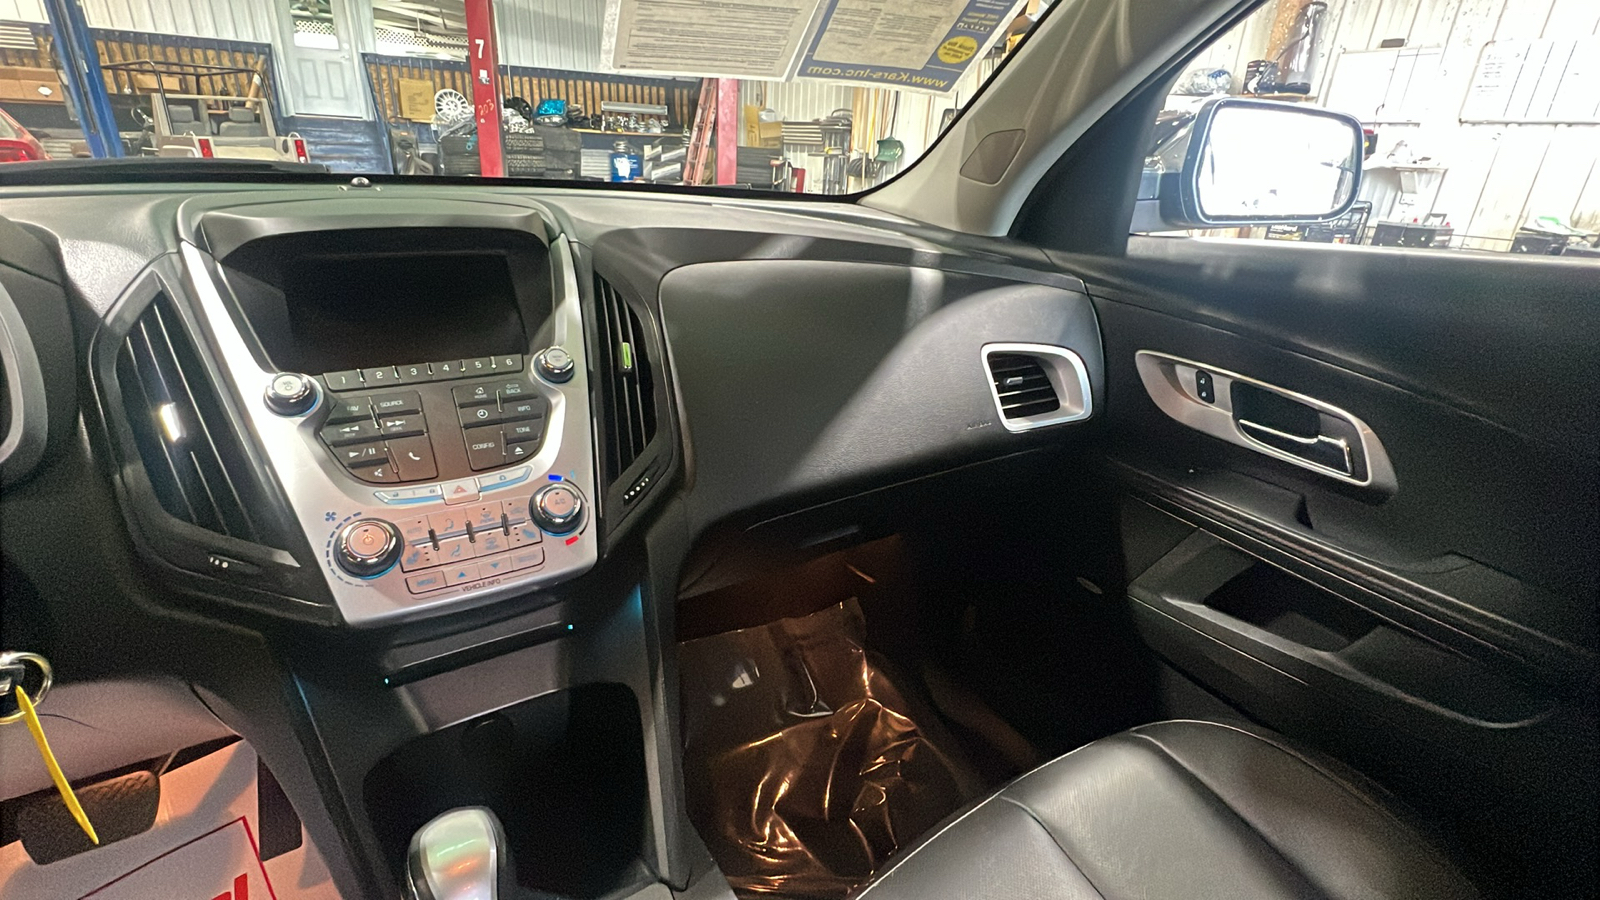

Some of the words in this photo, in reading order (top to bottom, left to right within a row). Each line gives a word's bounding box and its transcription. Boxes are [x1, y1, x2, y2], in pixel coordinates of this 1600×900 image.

[475, 39, 484, 59] 7
[475, 361, 482, 369] 5
[506, 358, 513, 366] 6
[375, 371, 383, 379] 2
[409, 367, 418, 375] 3
[341, 376, 346, 384] 1
[380, 399, 404, 408] SOURCE
[472, 441, 496, 451] CONFIG
[461, 582, 486, 592] VEHICLE
[485, 578, 501, 587] INFO
